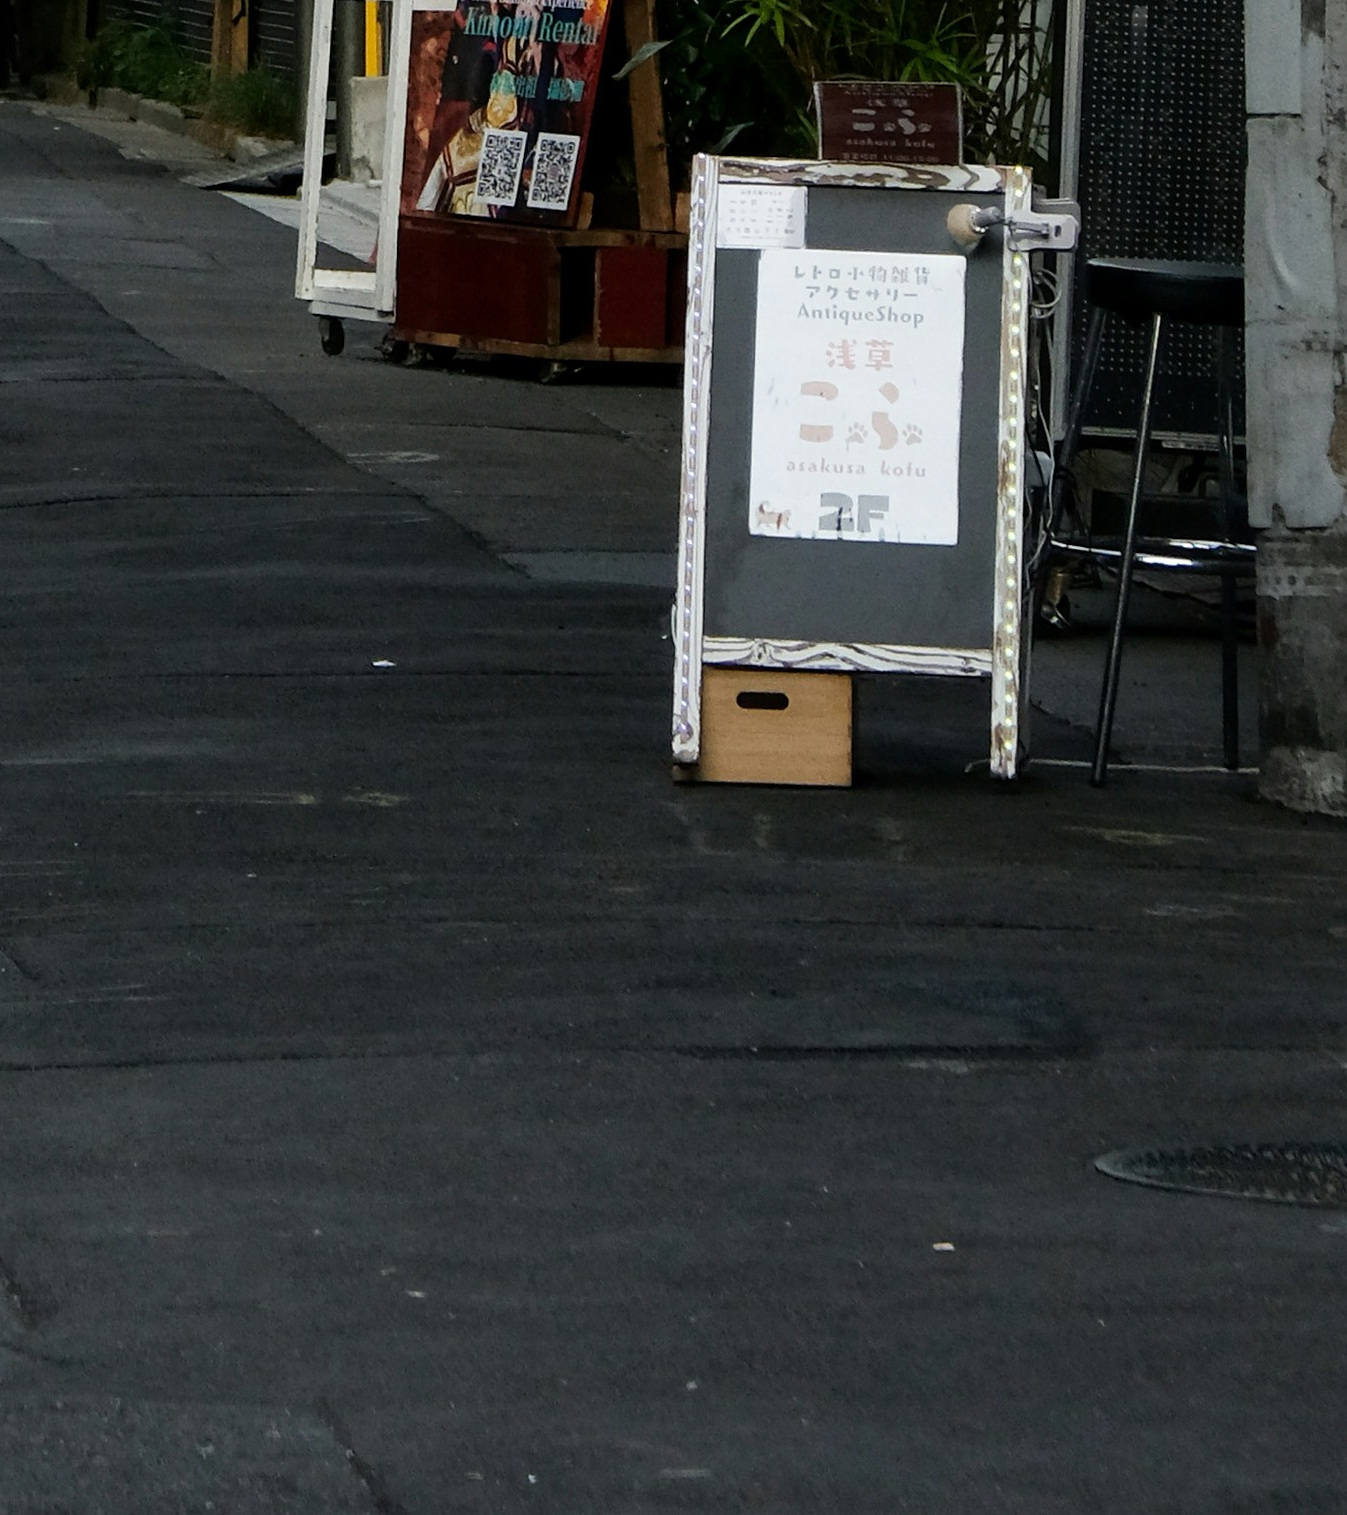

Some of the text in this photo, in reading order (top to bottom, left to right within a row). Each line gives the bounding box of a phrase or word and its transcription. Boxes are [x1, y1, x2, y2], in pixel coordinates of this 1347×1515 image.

[538, 11, 598, 46] Rental
[794, 265, 931, 286] レトロ小物雑貨
[806, 284, 918, 302] アクセサリー
[797, 302, 925, 330] AntiqueShop
[825, 338, 895, 371] 浅草
[786, 457, 927, 478] asakusa kofu
[818, 492, 890, 533] 2F
